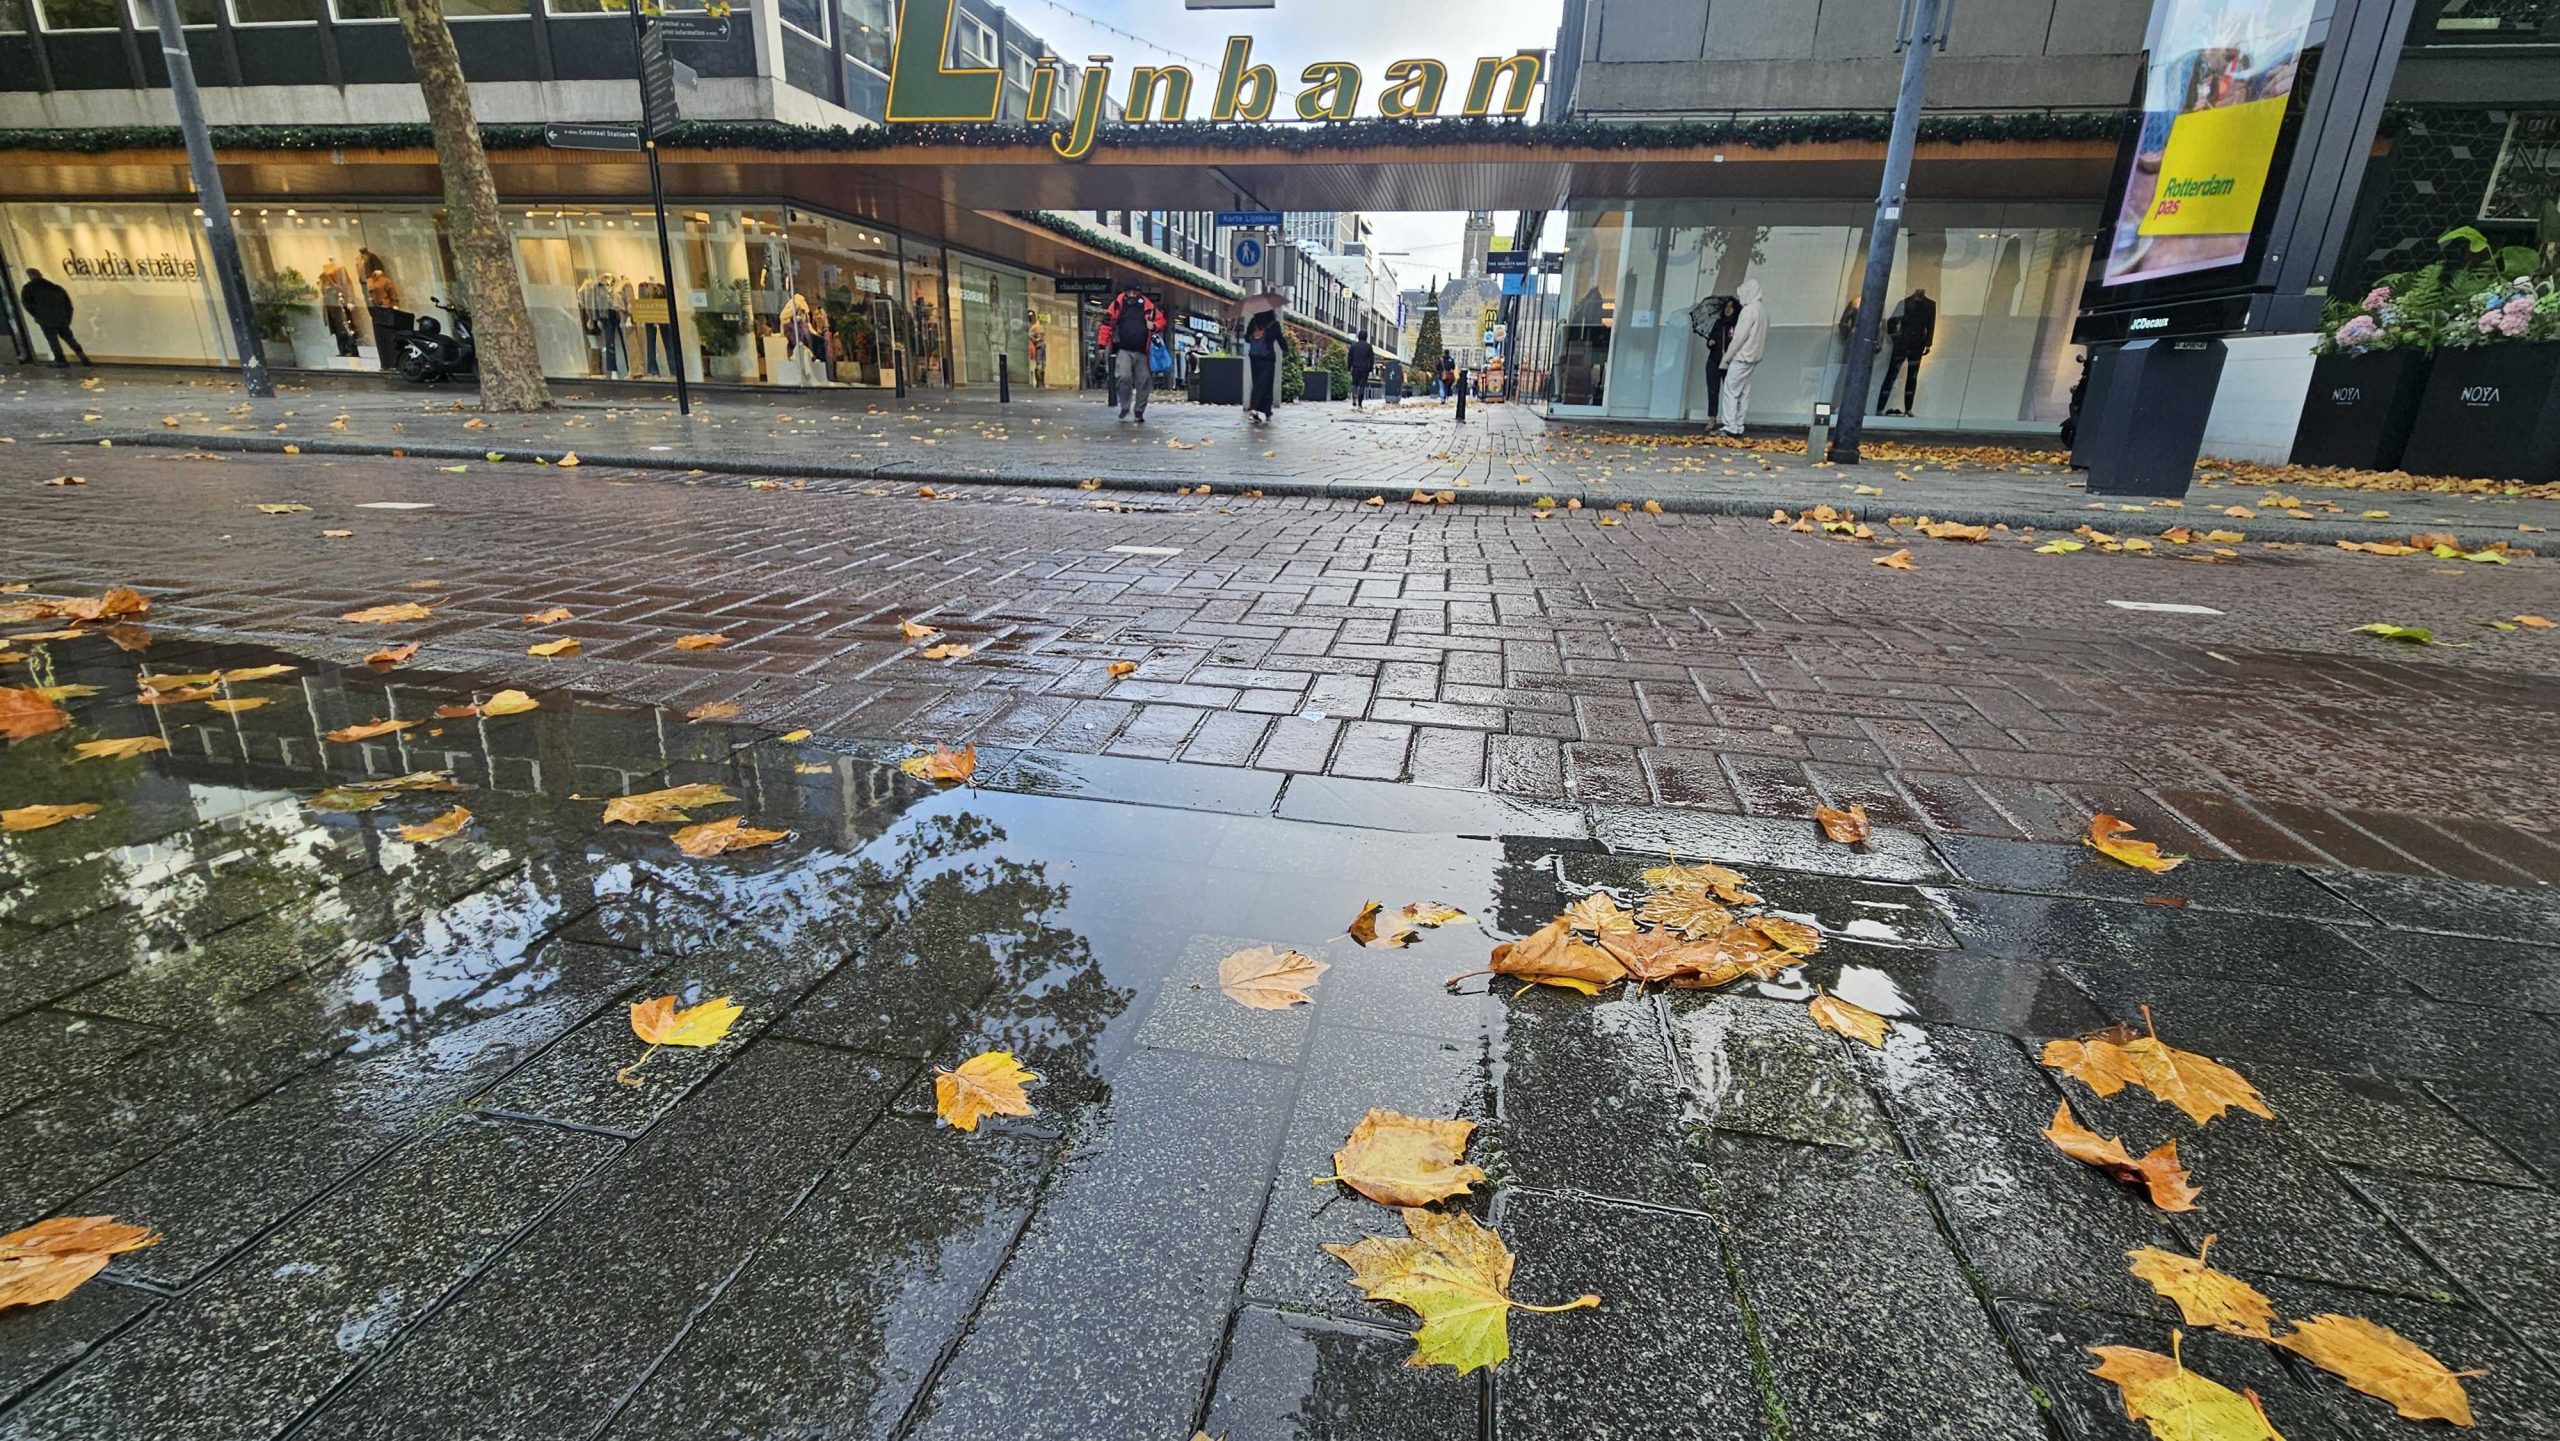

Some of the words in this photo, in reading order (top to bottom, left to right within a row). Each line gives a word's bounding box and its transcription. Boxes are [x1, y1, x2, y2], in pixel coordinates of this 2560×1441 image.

[885, 0, 1543, 160] Lijnbaan
[606, 130, 630, 138] Station
[2163, 174, 2236, 198] Rotterdam
[2153, 199, 2181, 220] pas
[62, 248, 135, 279] claudia
[2130, 317, 2169, 330] JCDecaux
[2332, 387, 2360, 400] NOYA
[2460, 386, 2500, 402] NOYA
